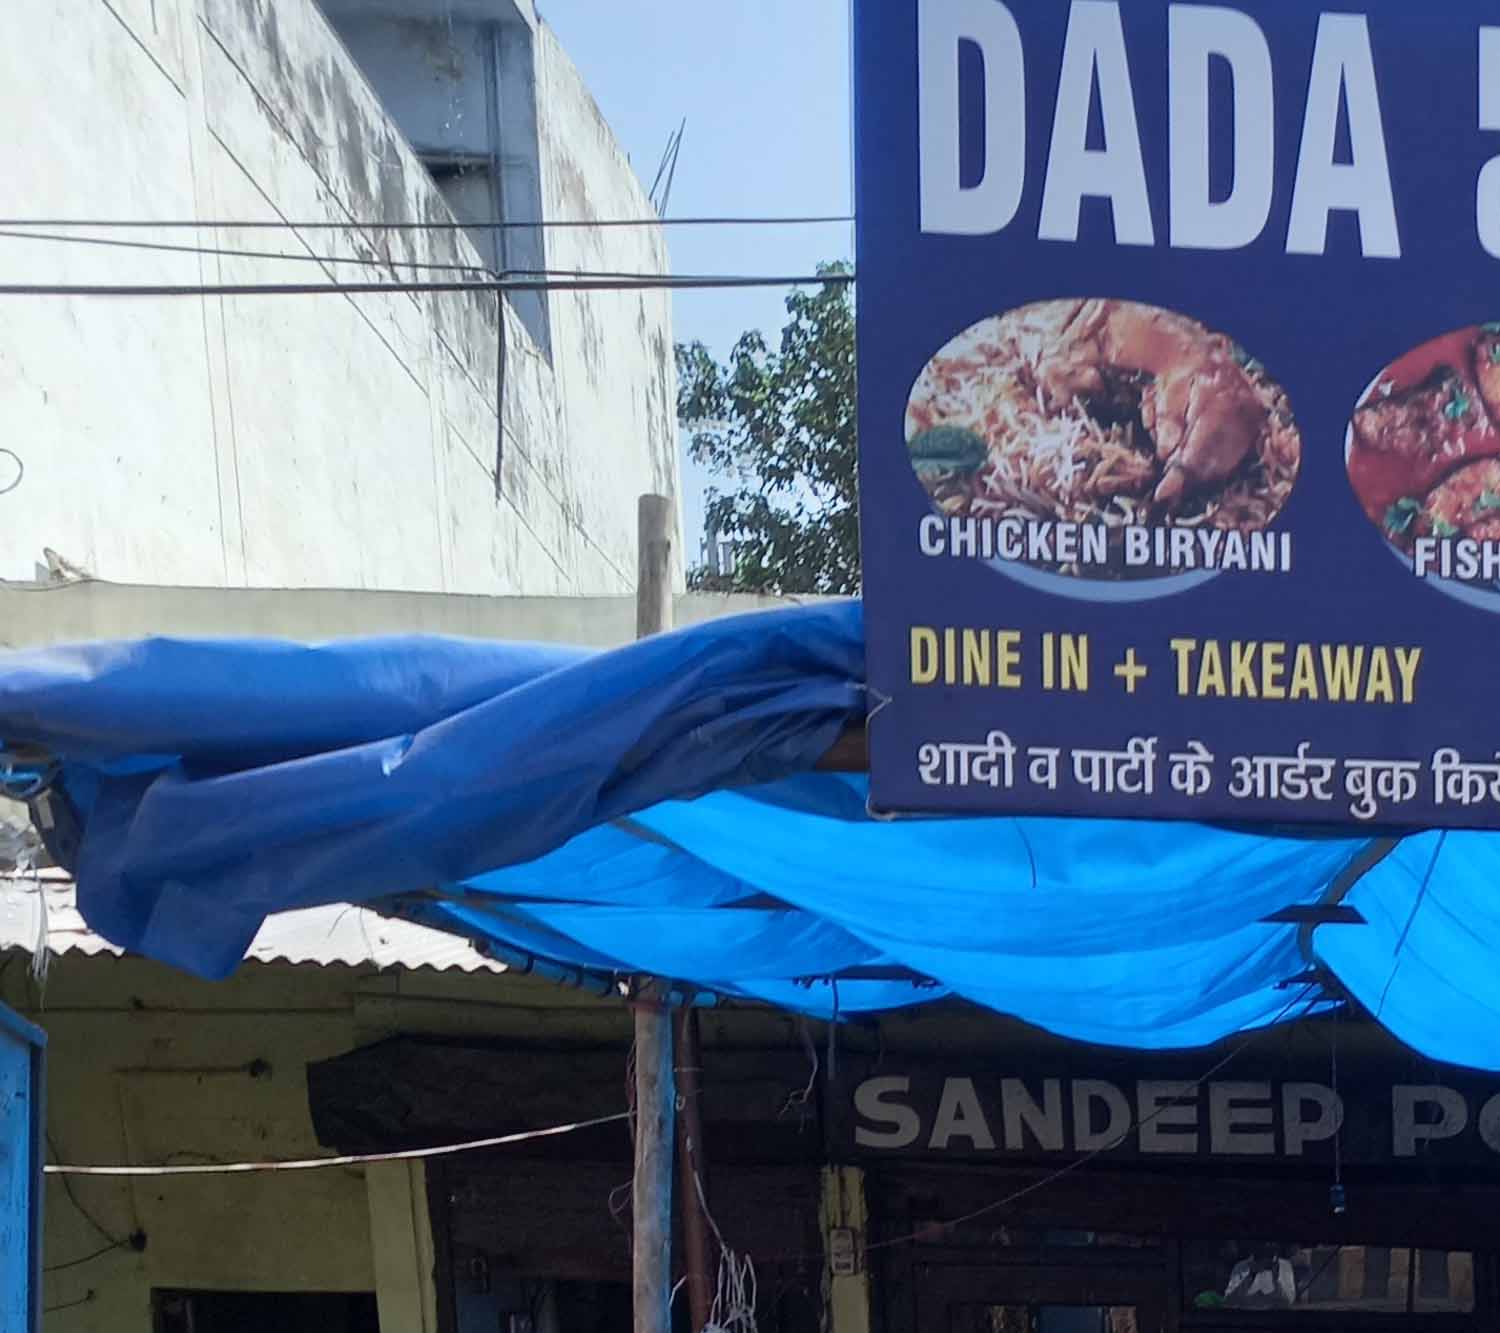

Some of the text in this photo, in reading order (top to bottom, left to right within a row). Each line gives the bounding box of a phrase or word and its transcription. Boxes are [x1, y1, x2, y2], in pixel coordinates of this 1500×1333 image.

[917, 0, 1401, 258] DADA
[917, 514, 1292, 572] CHICKEN BIRYANI
[909, 626, 1422, 704] DINE IN + TAKEAWAY
[917, 730, 1016, 788] शादी
[1028, 745, 1059, 790] व
[1070, 735, 1160, 794] पार्टी
[1168, 740, 1213, 796] के
[1228, 741, 1336, 802] आर्डर
[1344, 758, 1421, 820] बुक
[852, 1074, 1346, 1157] SANDEEP
